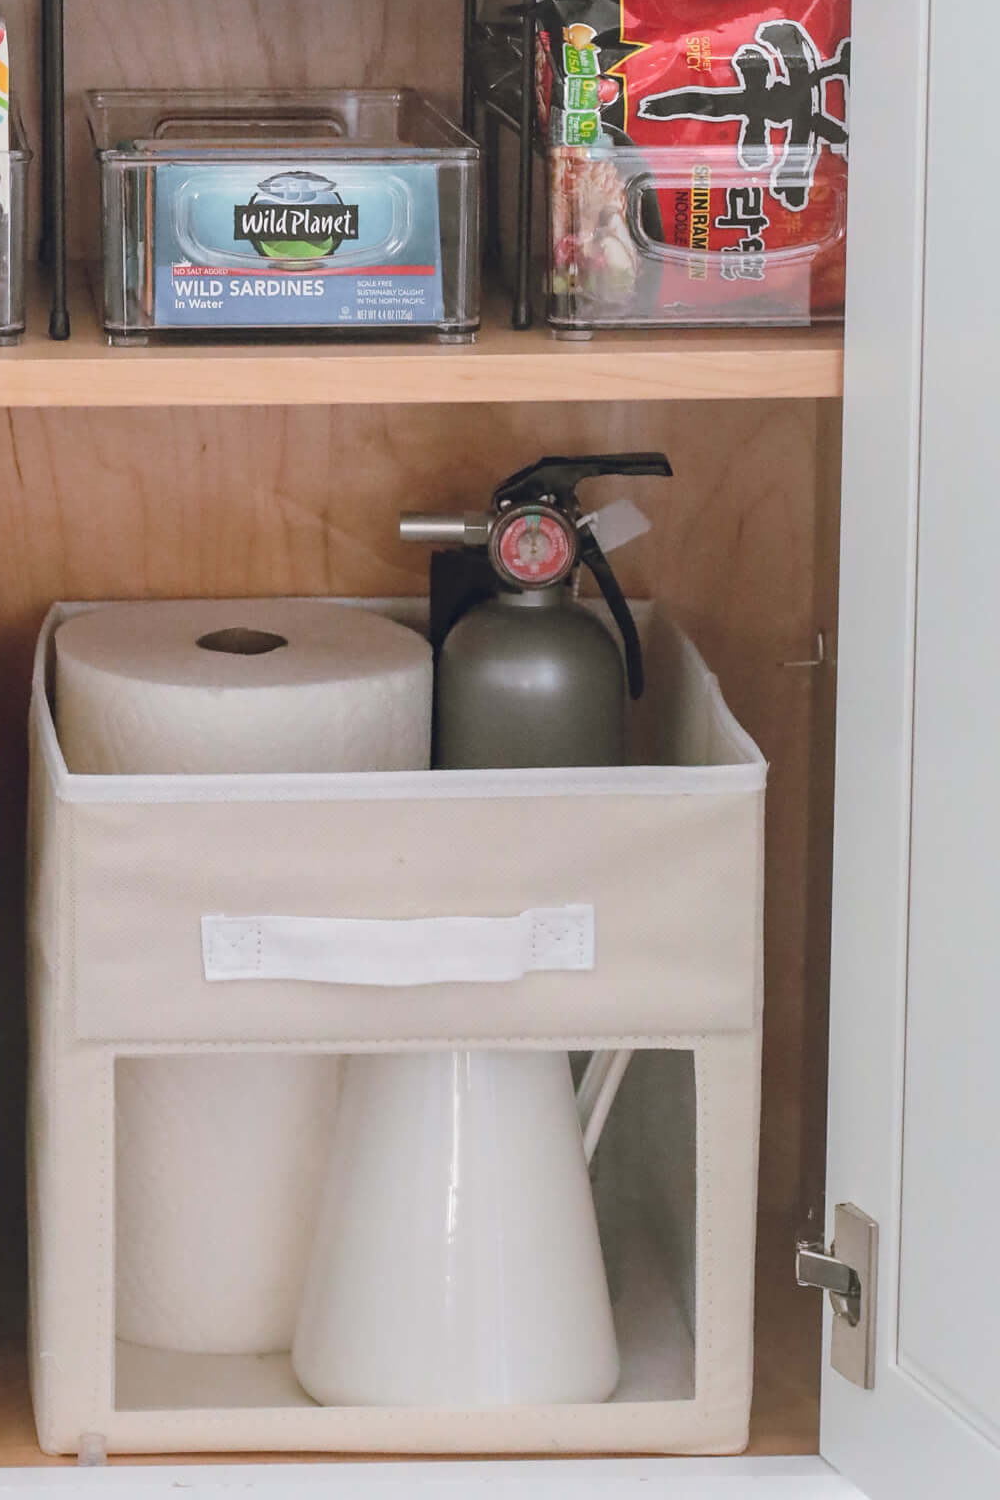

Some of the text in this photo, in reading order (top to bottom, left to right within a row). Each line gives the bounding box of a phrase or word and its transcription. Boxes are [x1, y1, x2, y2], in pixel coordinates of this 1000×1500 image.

[567, 50, 581, 73] USA
[686, 36, 700, 72] SPICY
[702, 36, 712, 73] GOURMET
[580, 120, 596, 138] 0g
[690, 165, 710, 211] SHIN
[242, 209, 352, 235] Wild Planet
[674, 190, 690, 245] NOODLE
[173, 266, 229, 276] NO SALT ADDED
[175, 280, 325, 297] WILD SARDINES
[175, 299, 223, 309] In Water
[366, 297, 378, 305] THE
[379, 297, 401, 305] NORTH
[357, 309, 367, 320] NET
[368, 309, 376, 320] WT
